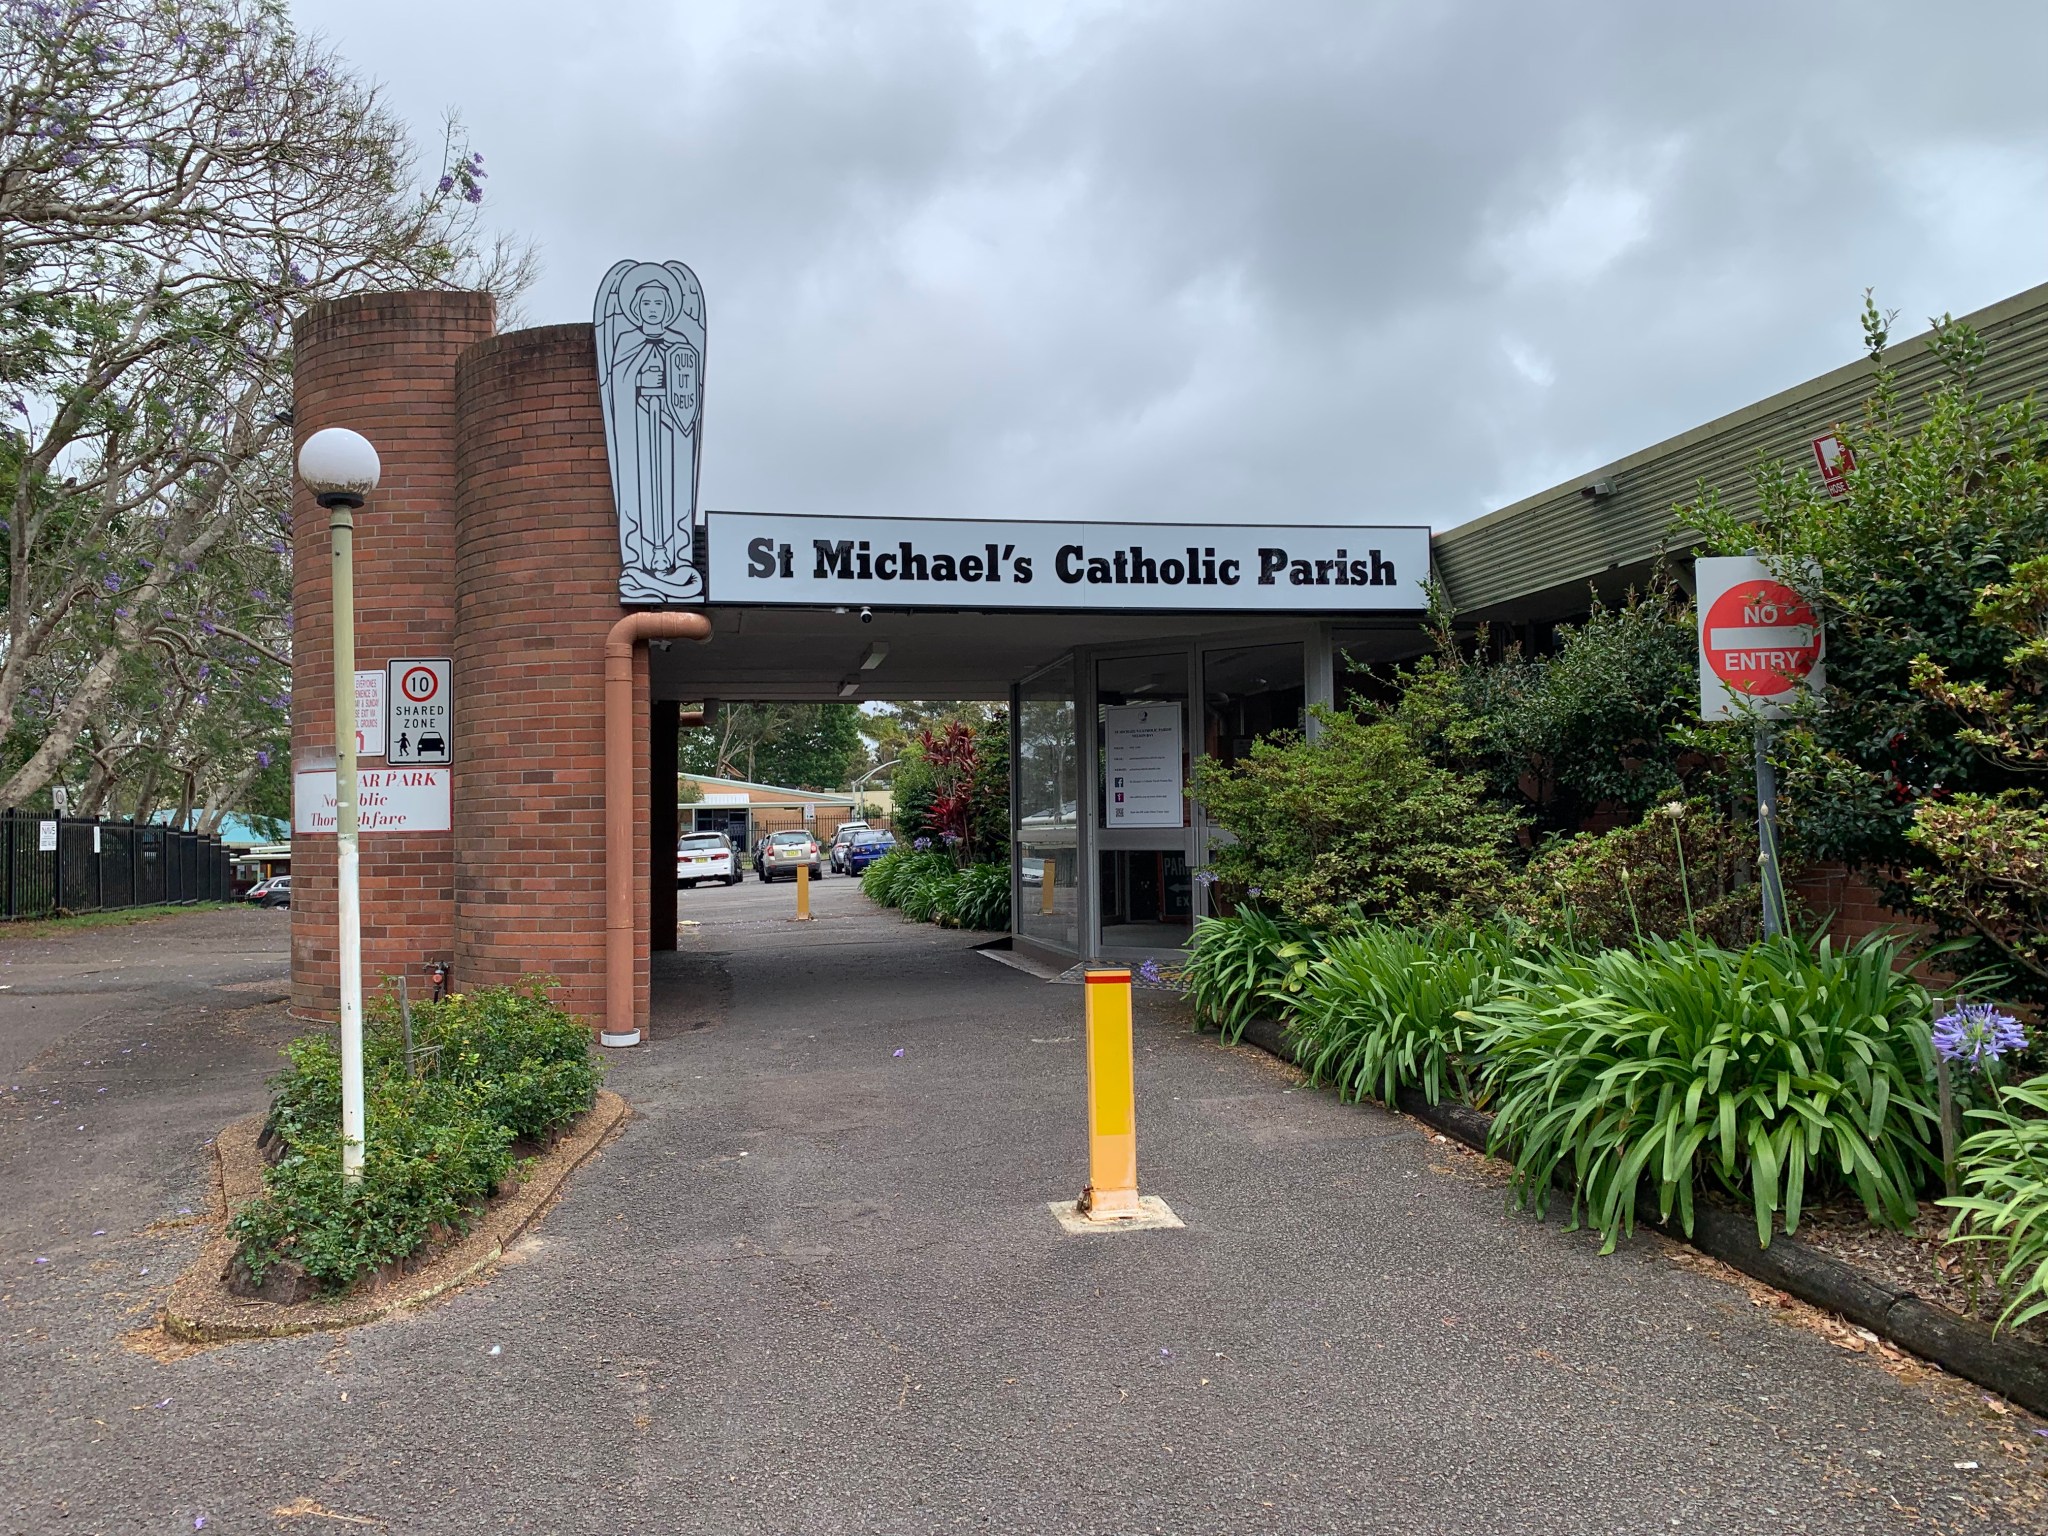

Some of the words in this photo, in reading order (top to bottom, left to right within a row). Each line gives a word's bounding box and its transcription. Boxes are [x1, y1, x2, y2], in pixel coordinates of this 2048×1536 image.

[675, 353, 694, 371] QUIS
[678, 374, 690, 389] UT
[673, 392, 694, 409] DEUS
[1828, 481, 1847, 495] HOSE
[747, 537, 794, 579] St
[812, 539, 1033, 584] Michael's
[1054, 544, 1241, 586] Catholic
[1257, 547, 1398, 587] Parish
[1743, 605, 1778, 625] NO
[1725, 651, 1800, 671] ENTRY
[411, 676, 429, 693] 10
[396, 705, 444, 716] SHARED
[404, 718, 436, 729] ZONE
[358, 773, 380, 788] AR
[385, 772, 437, 787] PARK
[322, 794, 337, 808] No
[359, 792, 388, 807] blic
